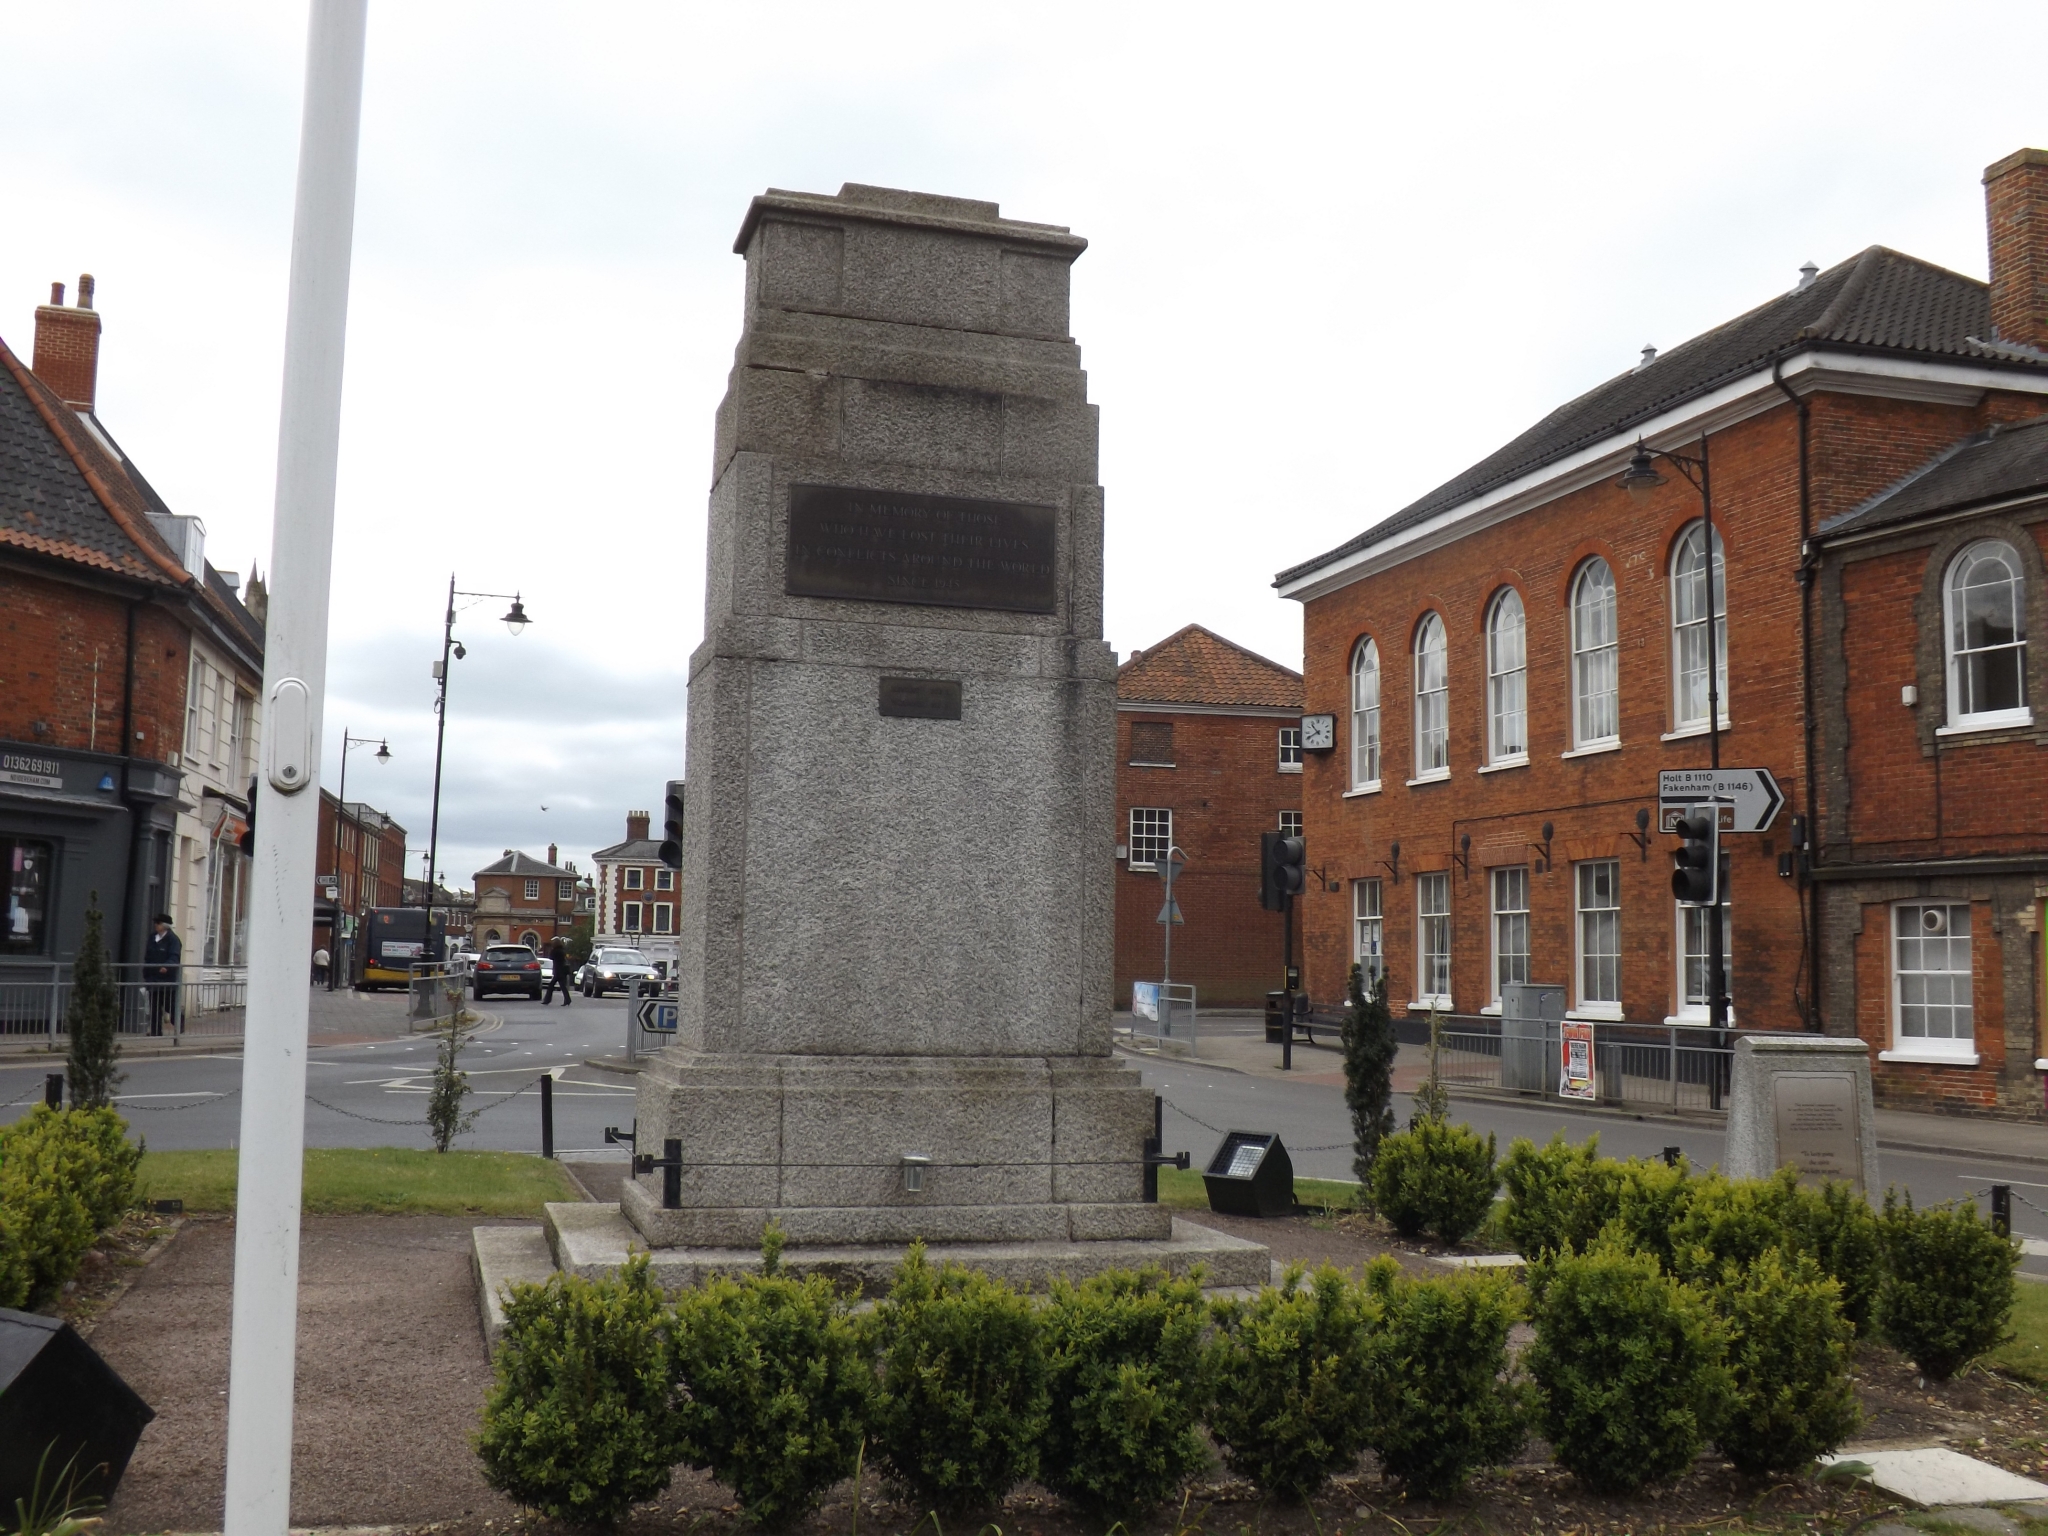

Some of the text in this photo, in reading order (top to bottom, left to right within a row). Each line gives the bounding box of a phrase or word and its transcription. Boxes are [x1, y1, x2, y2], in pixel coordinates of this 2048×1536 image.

[848, 502, 1002, 526] IN MEMORY OF THOSE
[819, 522, 1029, 550] WHO HAVE LOST THEIR LIVES
[795, 544, 1051, 576] IN CONFLICTS AROUND THE WORLD
[887, 576, 961, 590] SINCE 1945
[3, 755, 60, 775] 01362 691911
[1662, 773, 1713, 782] Holt B 1110
[1662, 783, 1710, 792] Fakenham
[1718, 815, 1732, 824] ife
[662, 1008, 677, 1027] P
